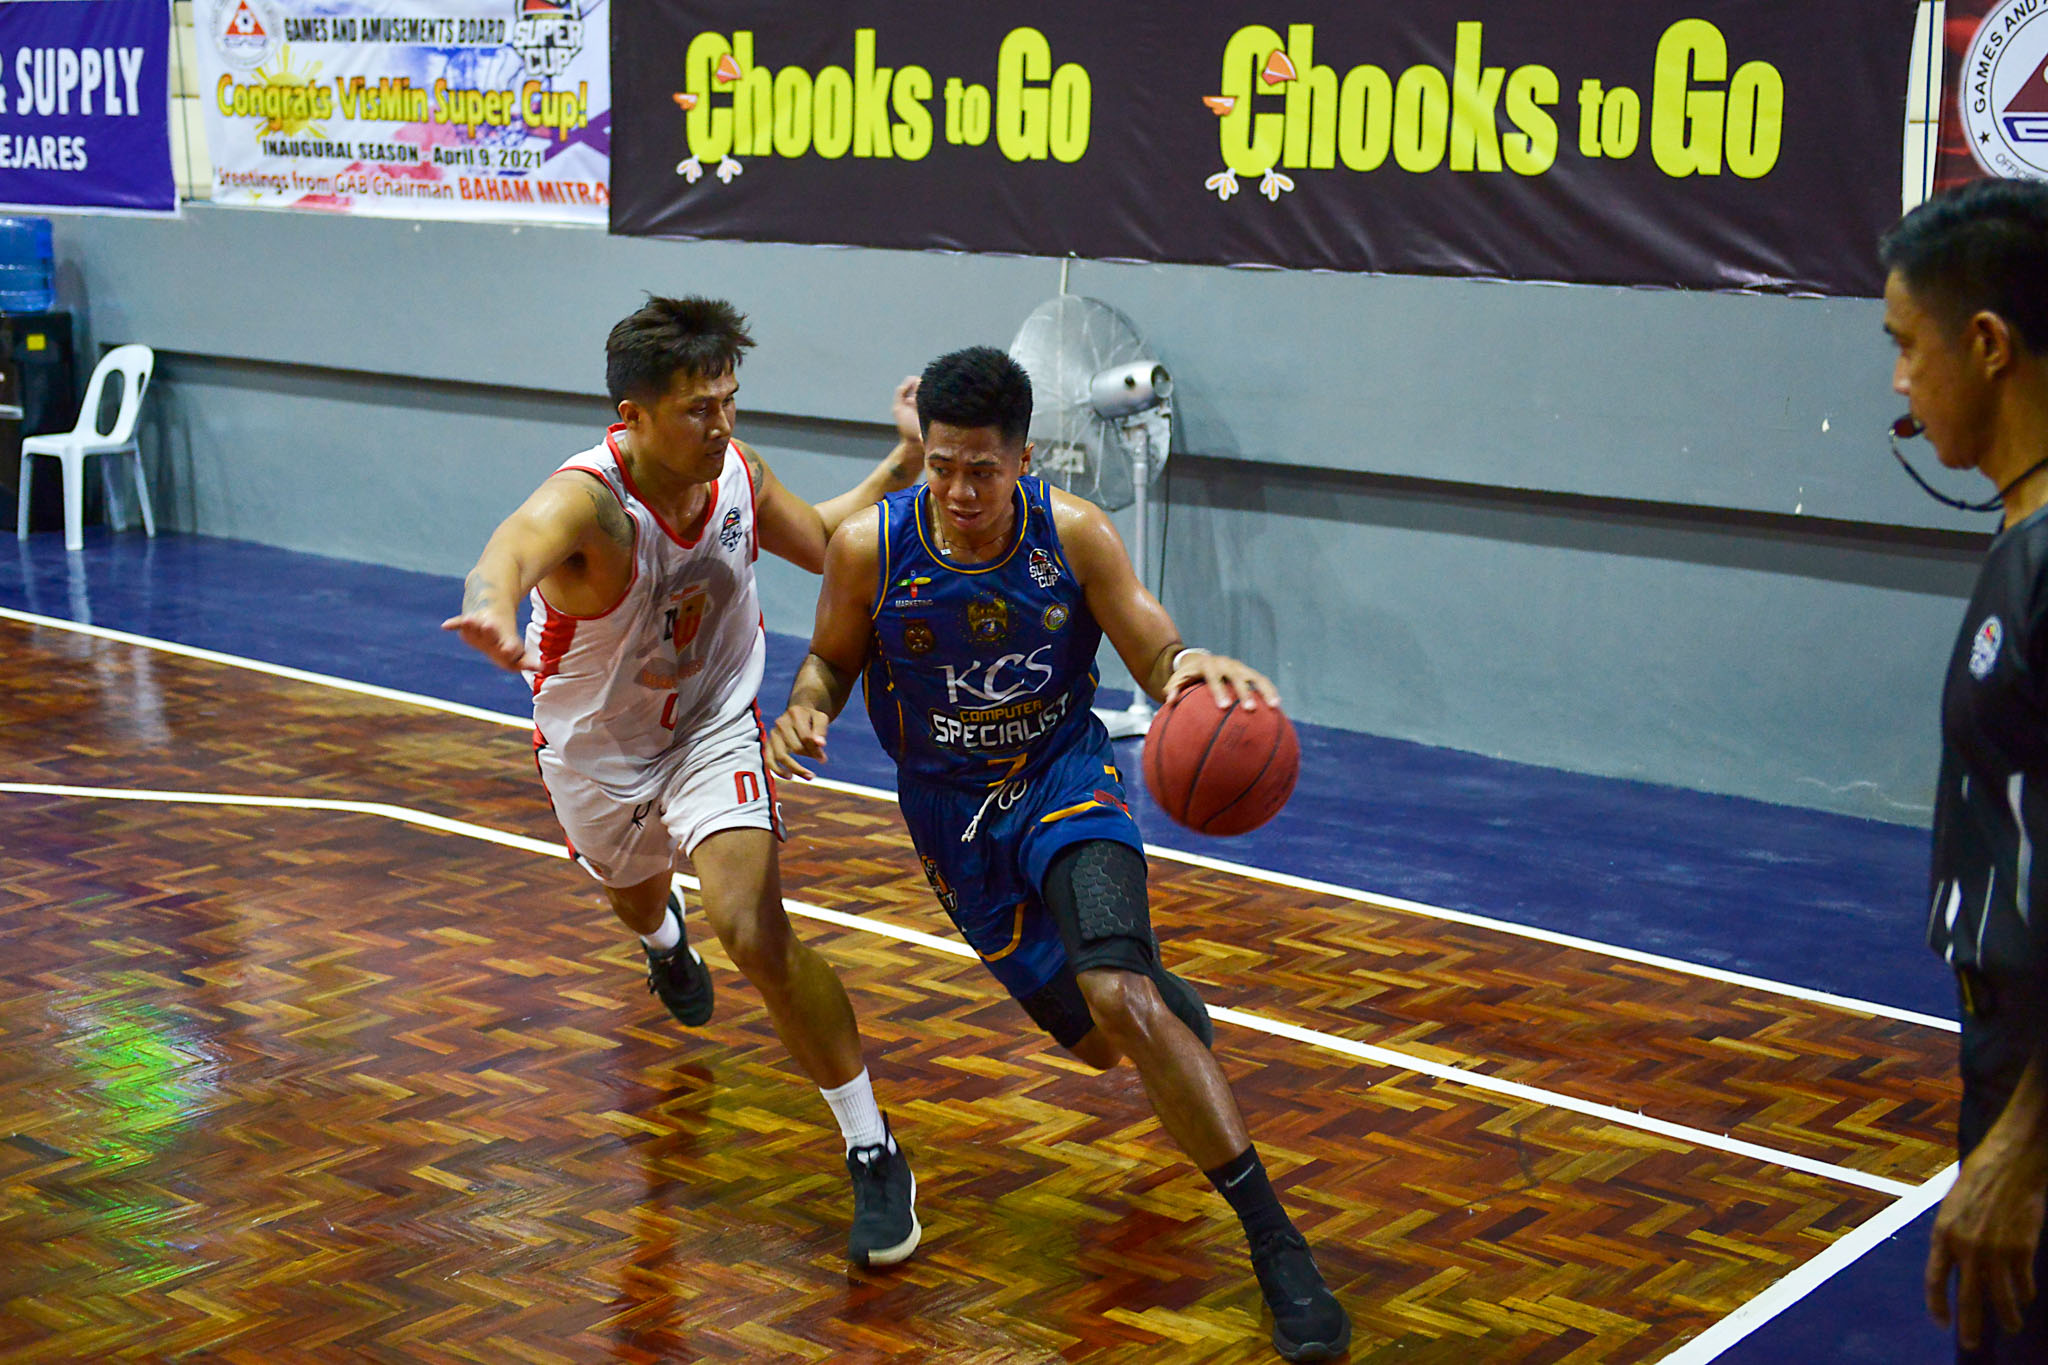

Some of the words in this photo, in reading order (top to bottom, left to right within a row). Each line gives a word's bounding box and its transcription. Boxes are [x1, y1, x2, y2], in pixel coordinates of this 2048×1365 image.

[285, 18, 328, 42] GAMES
[332, 18, 357, 42] AND
[361, 18, 454, 43] AMUSEMENTS
[458, 19, 505, 43] BOARD
[513, 19, 584, 49] SUPER
[1974, 31, 2003, 113] GAMES
[2005, 0, 2037, 32] AND
[15, 46, 144, 117] SUPPLY
[523, 47, 572, 76] CUP
[217, 73, 333, 130] Congrats
[335, 76, 429, 124] VisMin
[433, 78, 515, 139] Super
[521, 80, 588, 142] Cup!
[686, 29, 933, 163] Chooks
[944, 77, 990, 146] to
[997, 27, 1091, 163] Go
[1219, 21, 1559, 178] Chooks
[1578, 78, 1640, 159] to
[1650, 18, 1784, 179] Go
[262, 139, 353, 160] INAUGURAL
[358, 142, 418, 162] SEASON
[433, 147, 474, 166] April
[499, 149, 541, 168] 2021
[292, 170, 329, 192] from
[334, 173, 368, 194] GAB
[373, 175, 454, 200] Chairman
[458, 177, 534, 203] BAHAM
[932, 644, 1053, 704] KCS
[933, 692, 1069, 748] SPECIALIST
[960, 700, 1042, 723] COMPUTER
